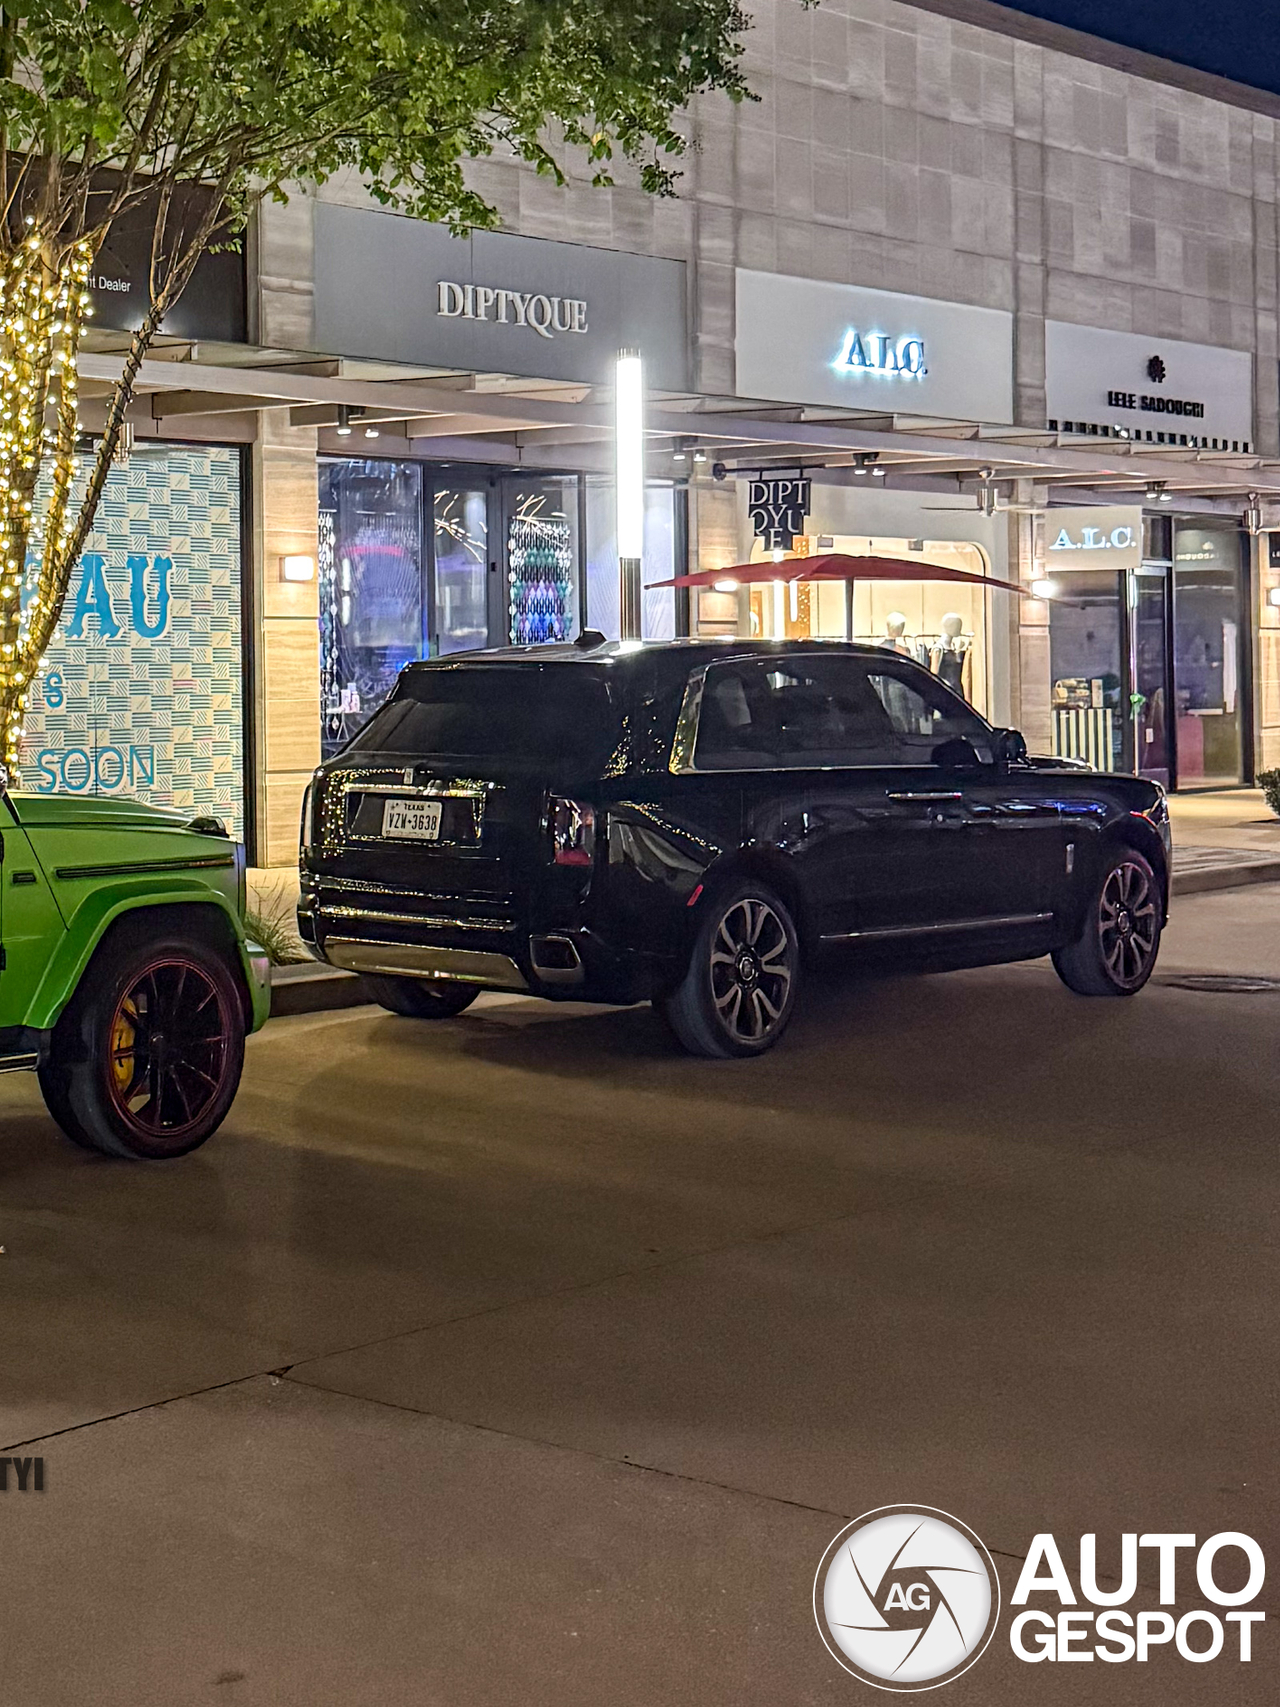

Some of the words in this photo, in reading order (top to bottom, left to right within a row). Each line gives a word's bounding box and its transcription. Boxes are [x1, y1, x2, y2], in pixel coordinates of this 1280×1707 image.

[98, 276, 131, 293] Dealer
[437, 281, 589, 338] DIPTYQUE
[749, 480, 807, 504] DIPT
[1048, 526, 1137, 550] A.L.C.
[36, 745, 155, 792] SOON
[404, 803, 425, 811] TEXAS
